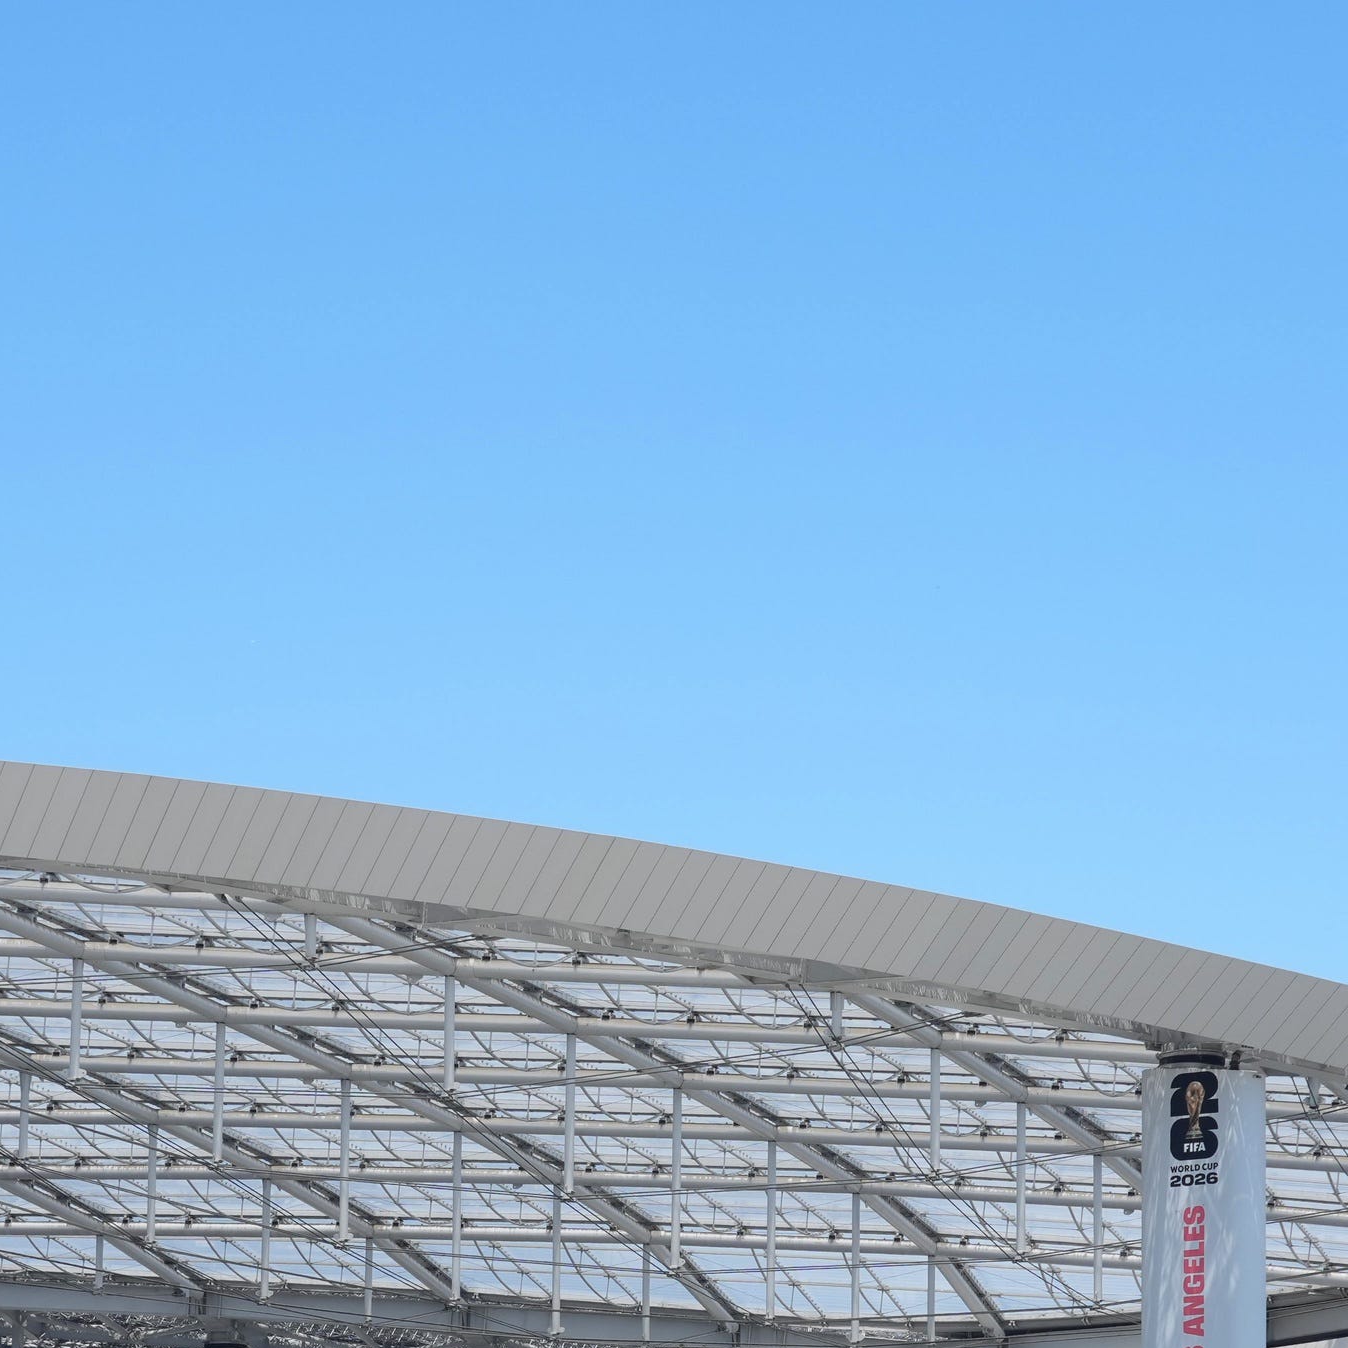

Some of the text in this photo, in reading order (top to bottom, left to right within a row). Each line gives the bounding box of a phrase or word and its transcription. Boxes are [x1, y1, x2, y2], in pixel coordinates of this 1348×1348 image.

[1183, 1142, 1206, 1153] FIFA
[1170, 1162, 1218, 1174] WORLD CUP
[1170, 1172, 1219, 1188] 2026
[1183, 1205, 1206, 1337] ANGELES
